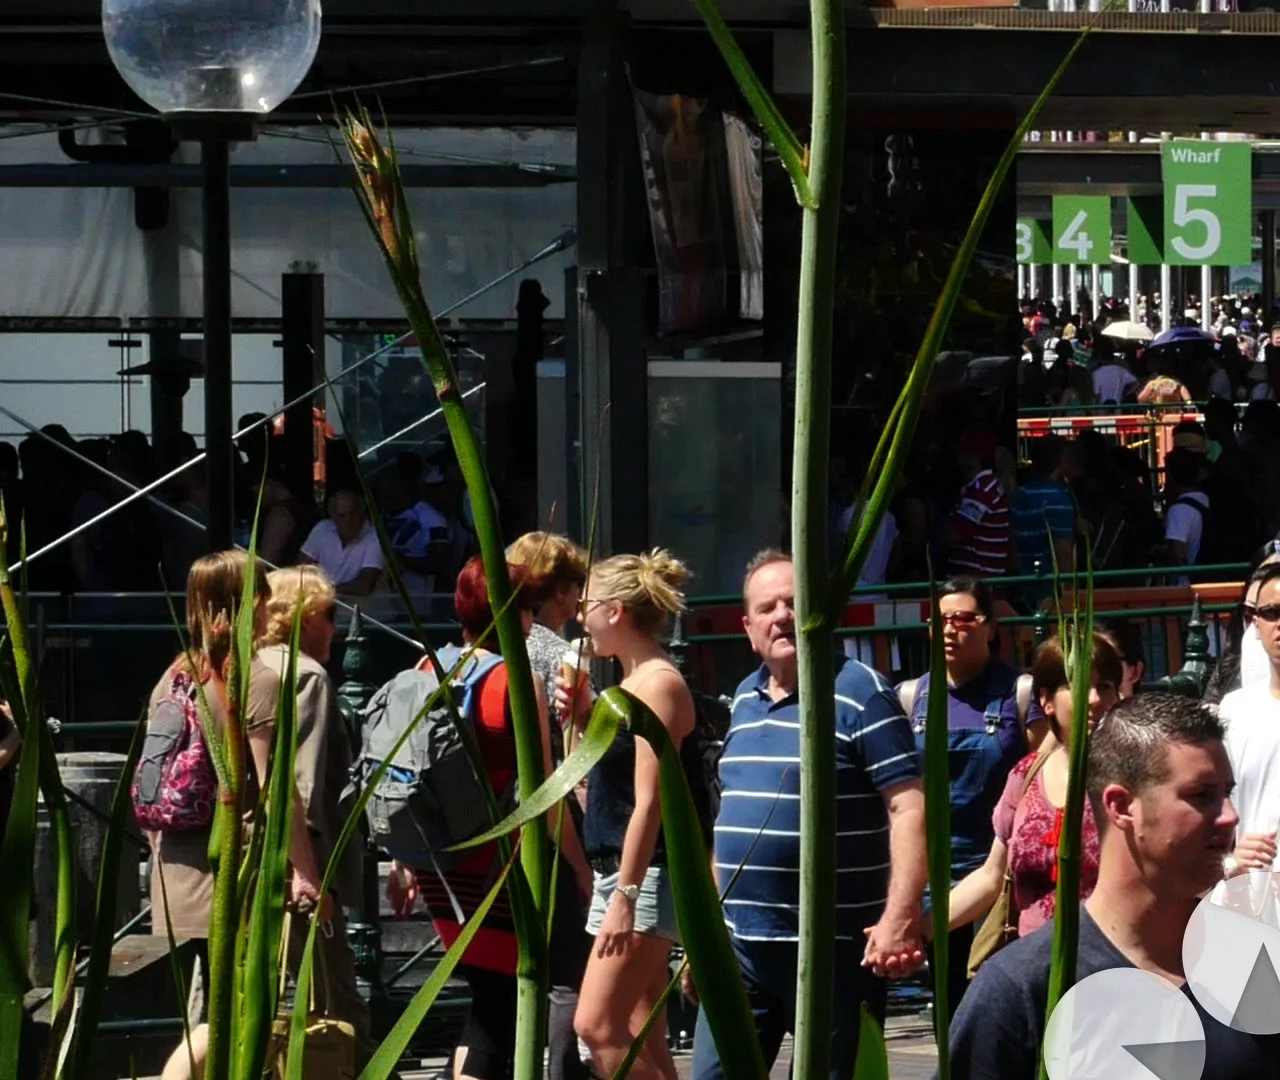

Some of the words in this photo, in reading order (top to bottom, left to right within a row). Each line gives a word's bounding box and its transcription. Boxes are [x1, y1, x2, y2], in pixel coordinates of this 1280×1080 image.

[1171, 148, 1221, 163] Wharf
[1016, 223, 1033, 261] 3
[1058, 210, 1094, 260] 4
[1171, 184, 1221, 260] 5
